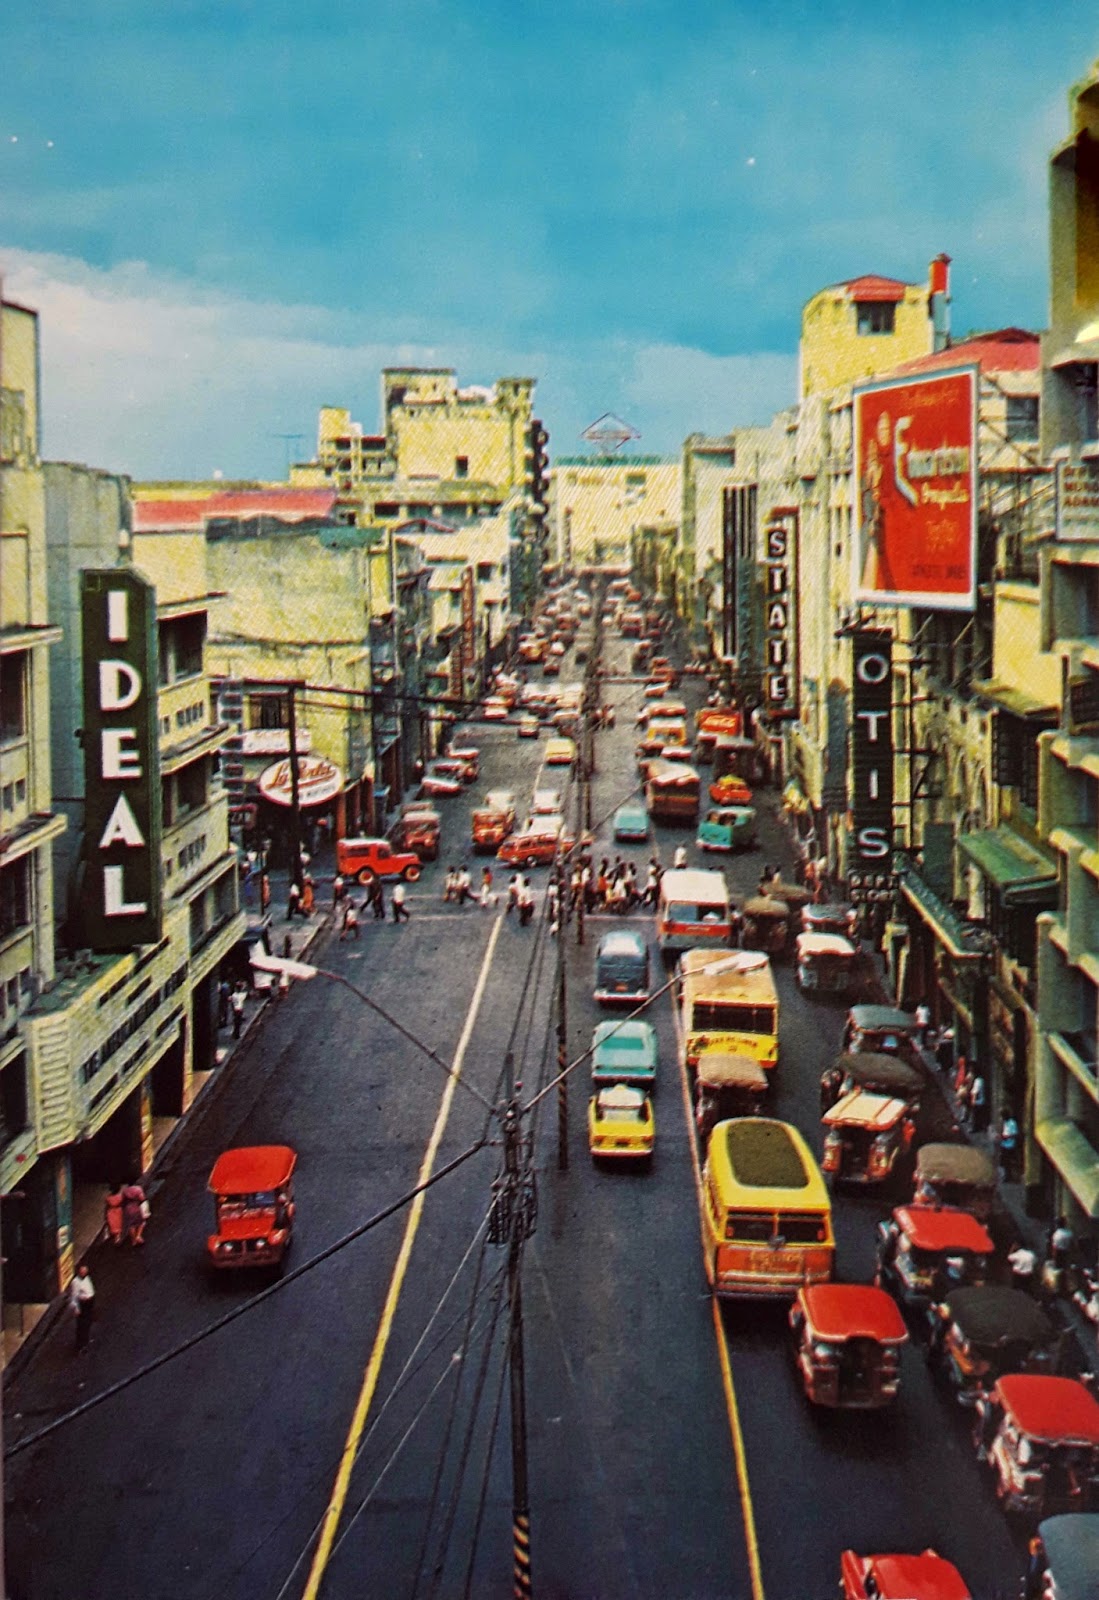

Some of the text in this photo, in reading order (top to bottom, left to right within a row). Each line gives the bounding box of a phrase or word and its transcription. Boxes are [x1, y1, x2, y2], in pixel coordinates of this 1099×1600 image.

[768, 530, 787, 700] STATE
[98, 589, 148, 916] IDEAL
[856, 655, 890, 859] OTIS
